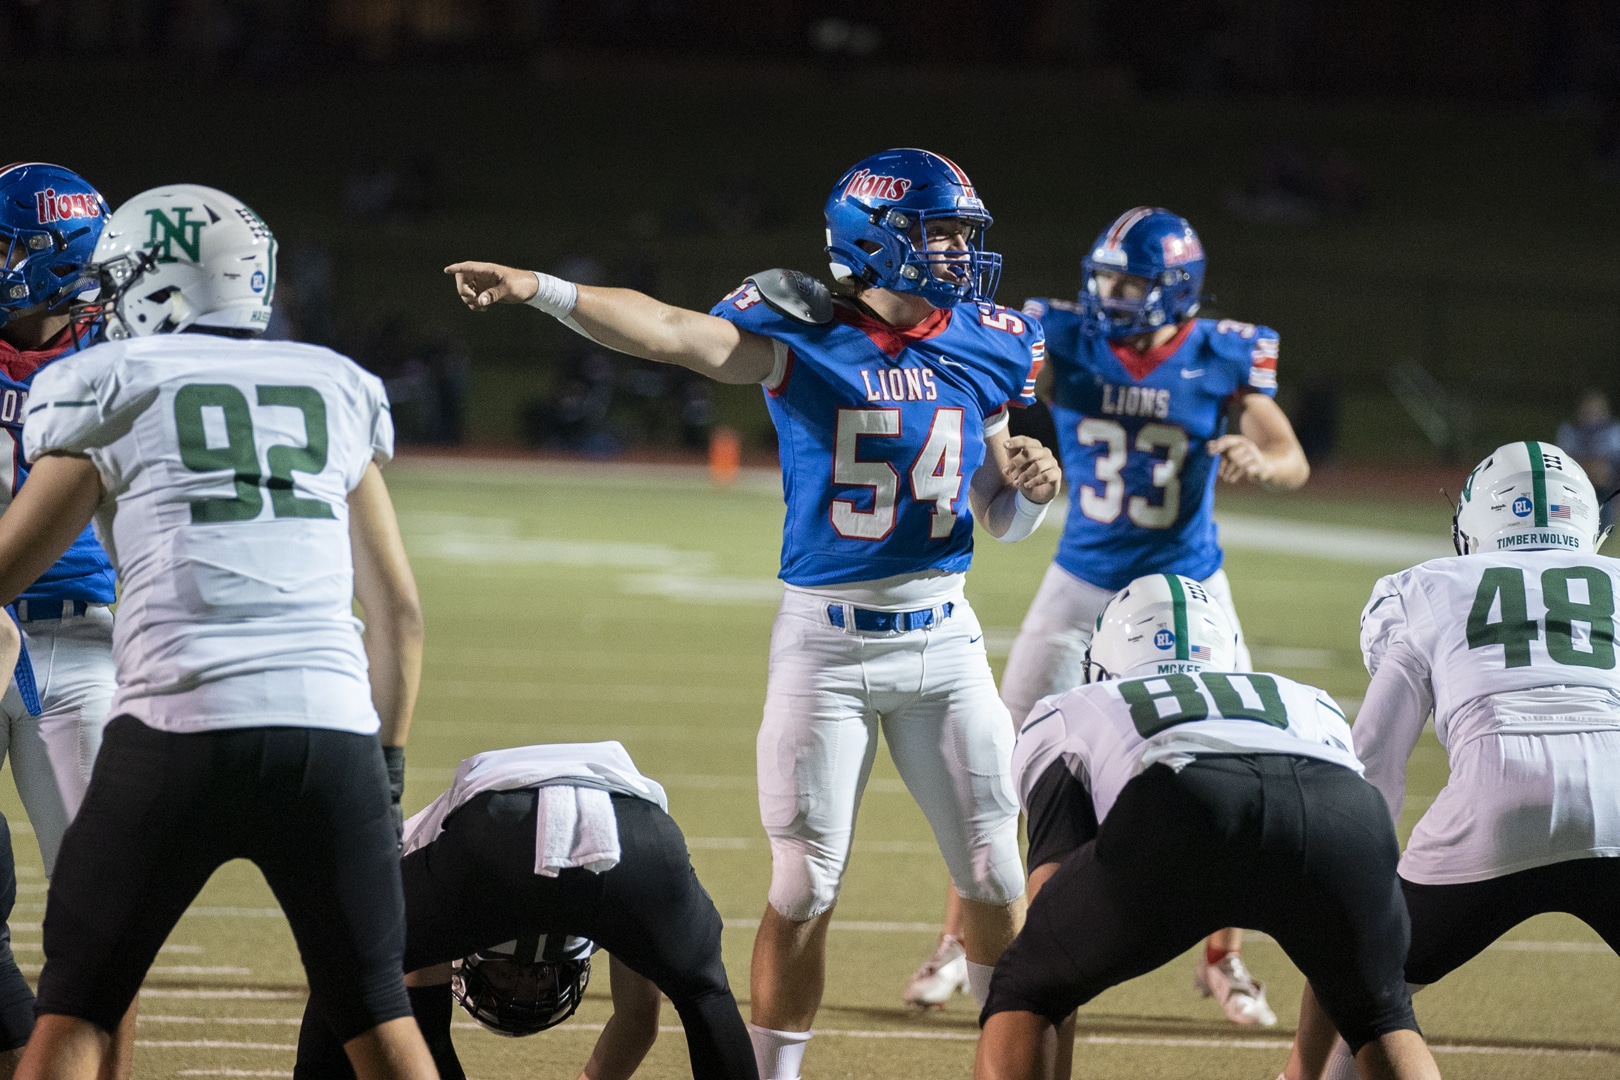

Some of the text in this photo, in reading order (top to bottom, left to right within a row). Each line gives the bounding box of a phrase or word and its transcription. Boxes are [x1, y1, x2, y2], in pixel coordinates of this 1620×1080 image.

[841, 168, 912, 202] lions
[35, 188, 99, 224] lions
[860, 367, 938, 402] LIONS
[1101, 384, 1171, 419] LIONS
[174, 383, 339, 524] 92
[830, 406, 965, 542] 54
[1076, 417, 1189, 530] 33
[1514, 500, 1531, 514] RL
[1466, 566, 1616, 670] 48
[1156, 633, 1174, 646] RL
[1118, 671, 1289, 740] 80
